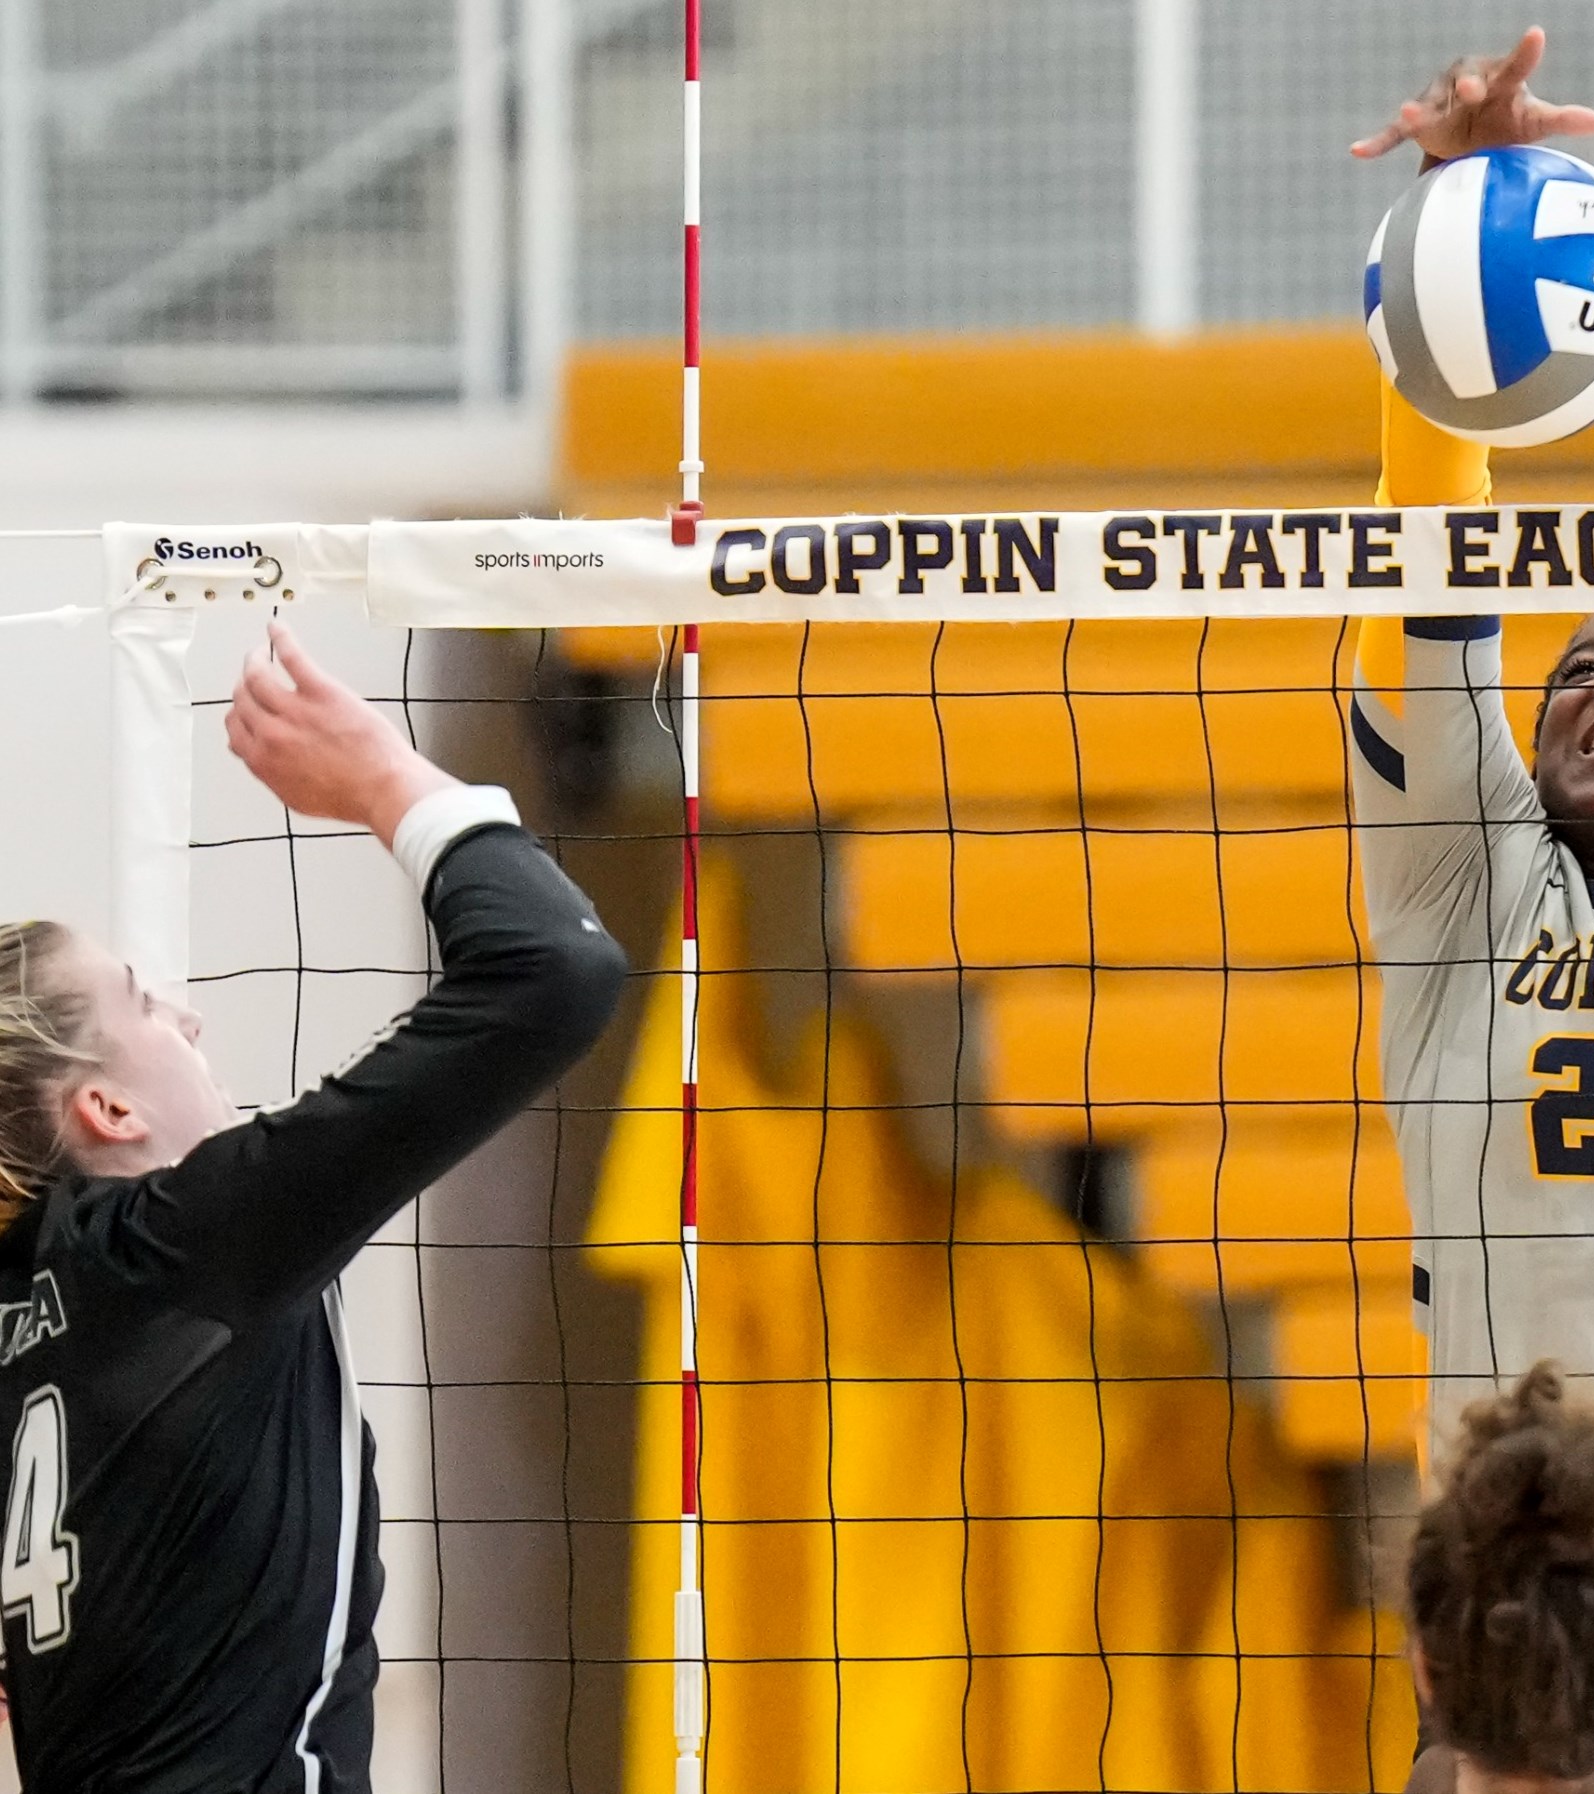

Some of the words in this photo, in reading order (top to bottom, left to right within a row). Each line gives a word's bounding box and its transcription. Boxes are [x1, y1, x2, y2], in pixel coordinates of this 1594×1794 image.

[177, 541, 263, 559] Senoh
[474, 551, 530, 571] sports
[709, 516, 1060, 597] COPPIN
[1102, 512, 1404, 591] STATE
[0, 1383, 80, 1660] 4
